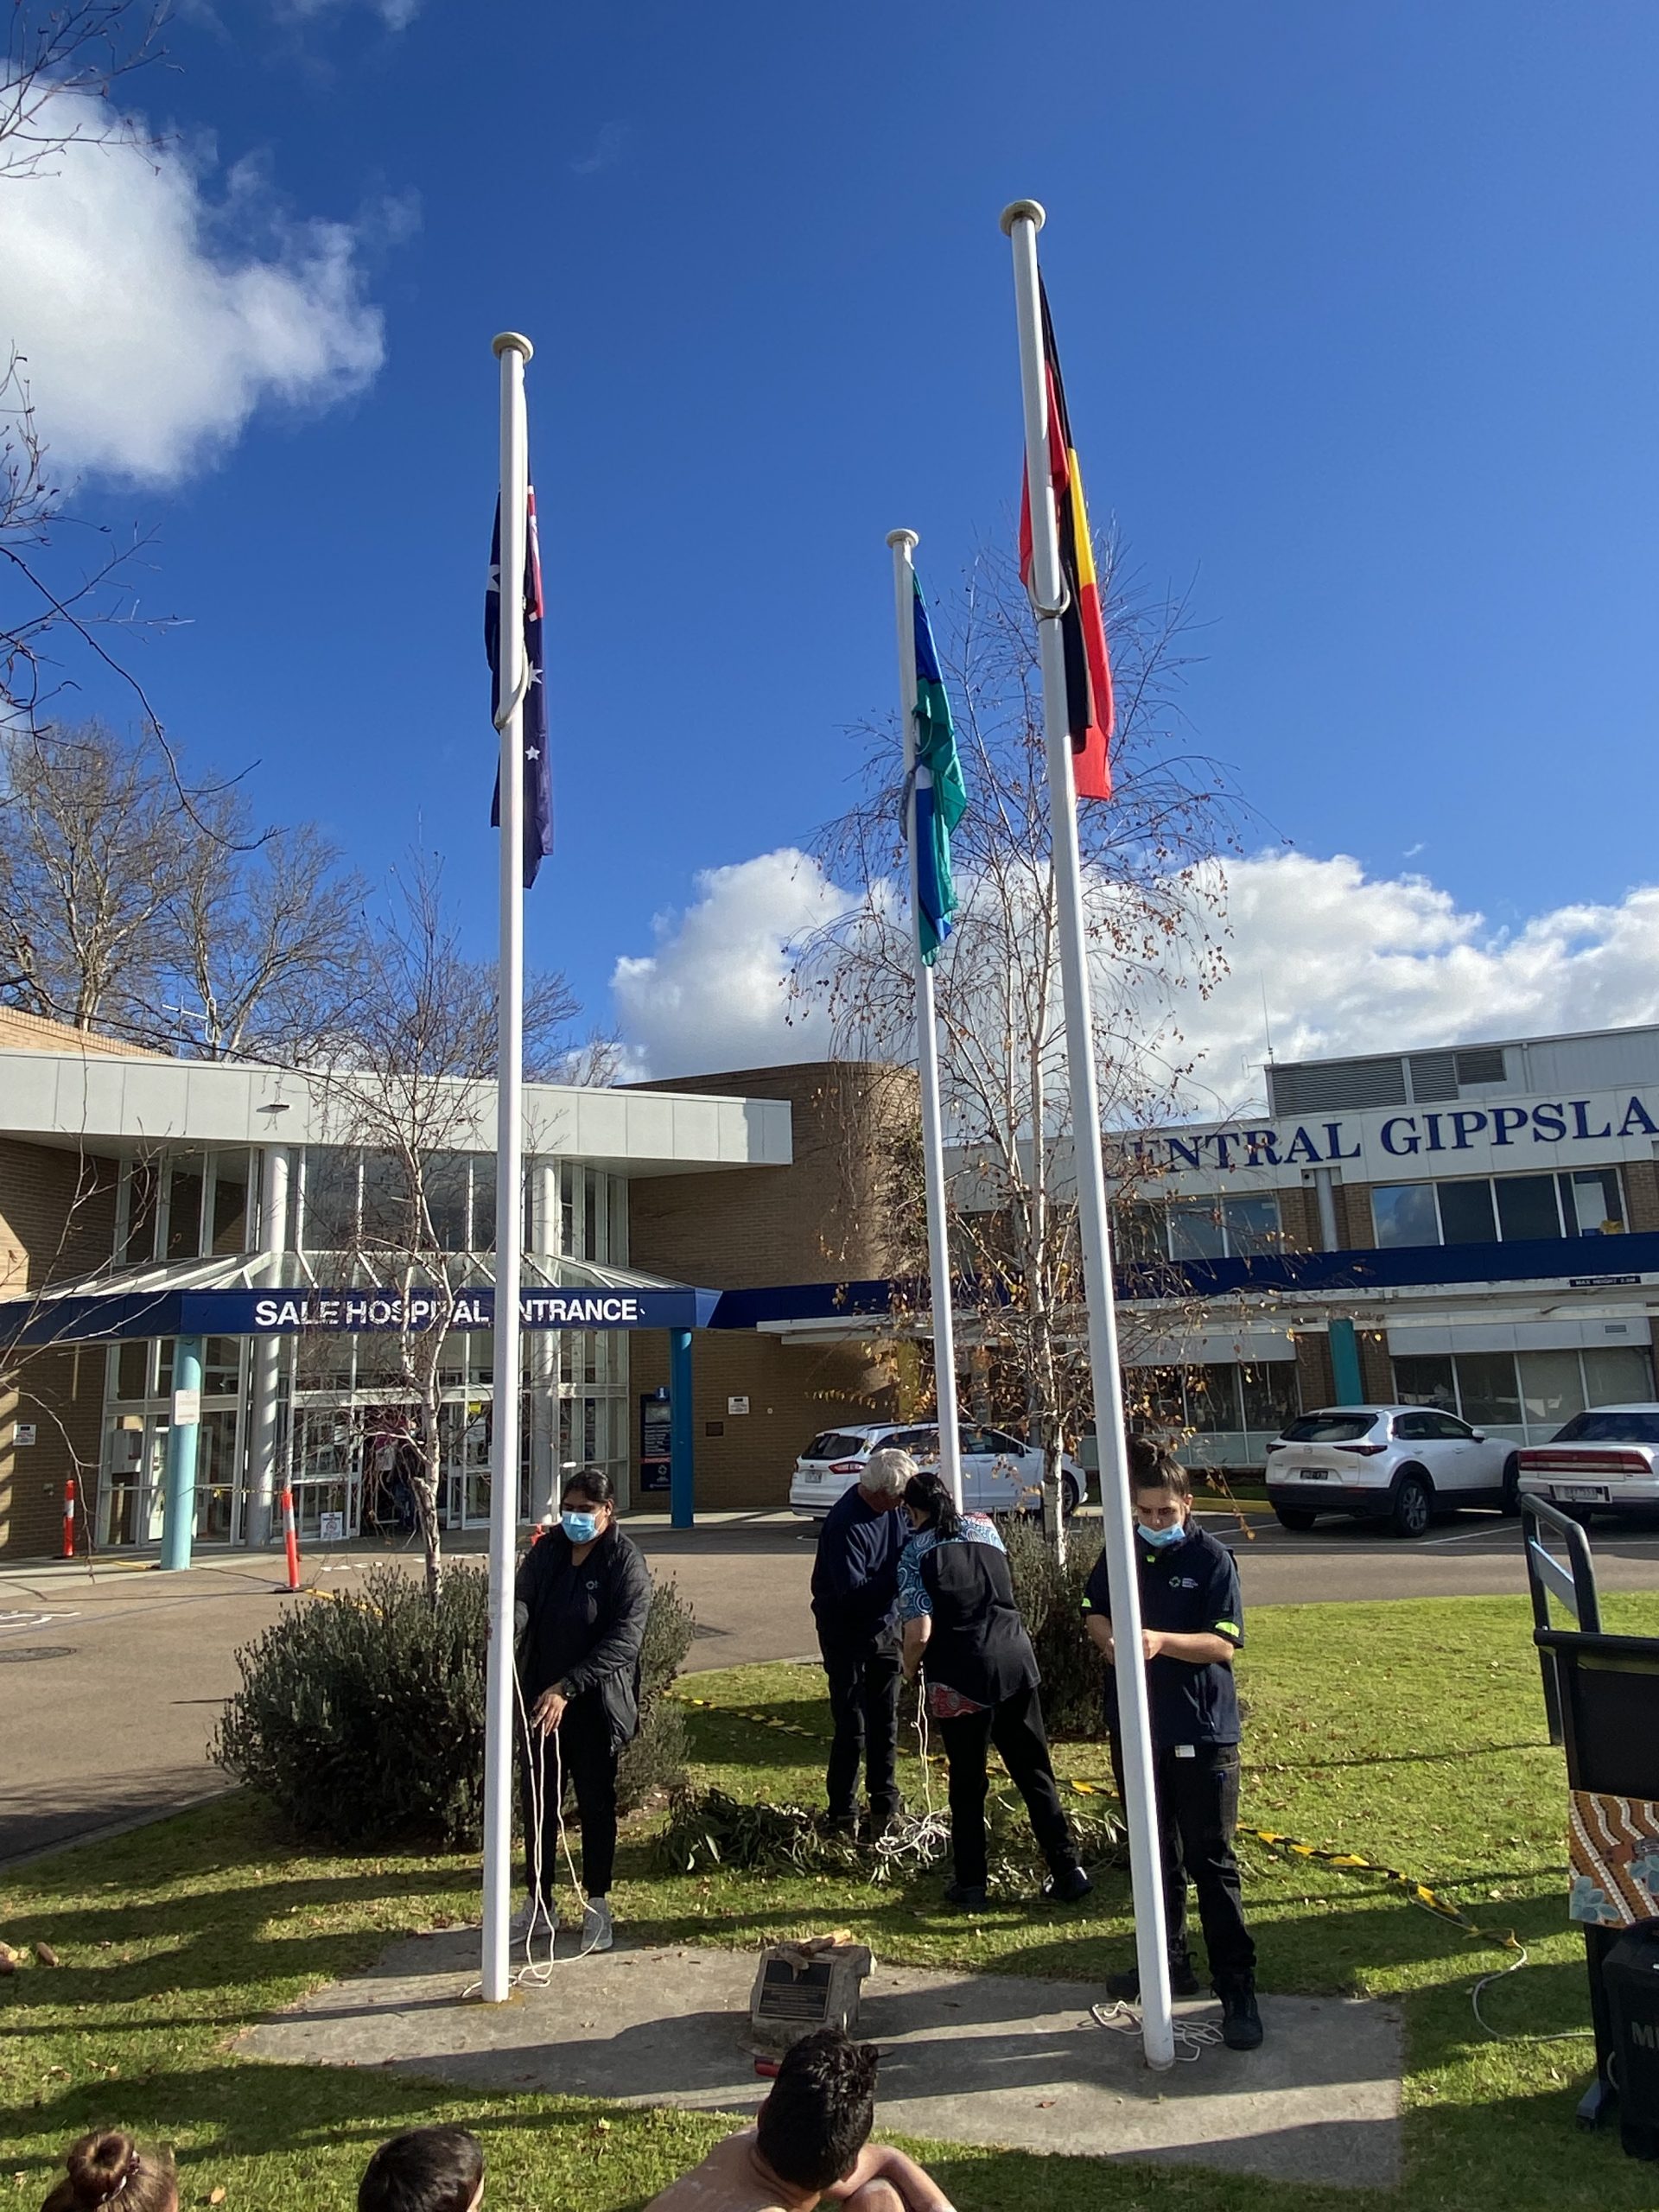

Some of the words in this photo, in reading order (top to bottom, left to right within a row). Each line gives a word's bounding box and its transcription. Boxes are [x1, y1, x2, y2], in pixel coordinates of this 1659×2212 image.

[1380, 1096, 1659, 1156] GIPPSLA
[255, 1300, 340, 1326] SALE
[518, 1298, 638, 1322] NTRANCE
